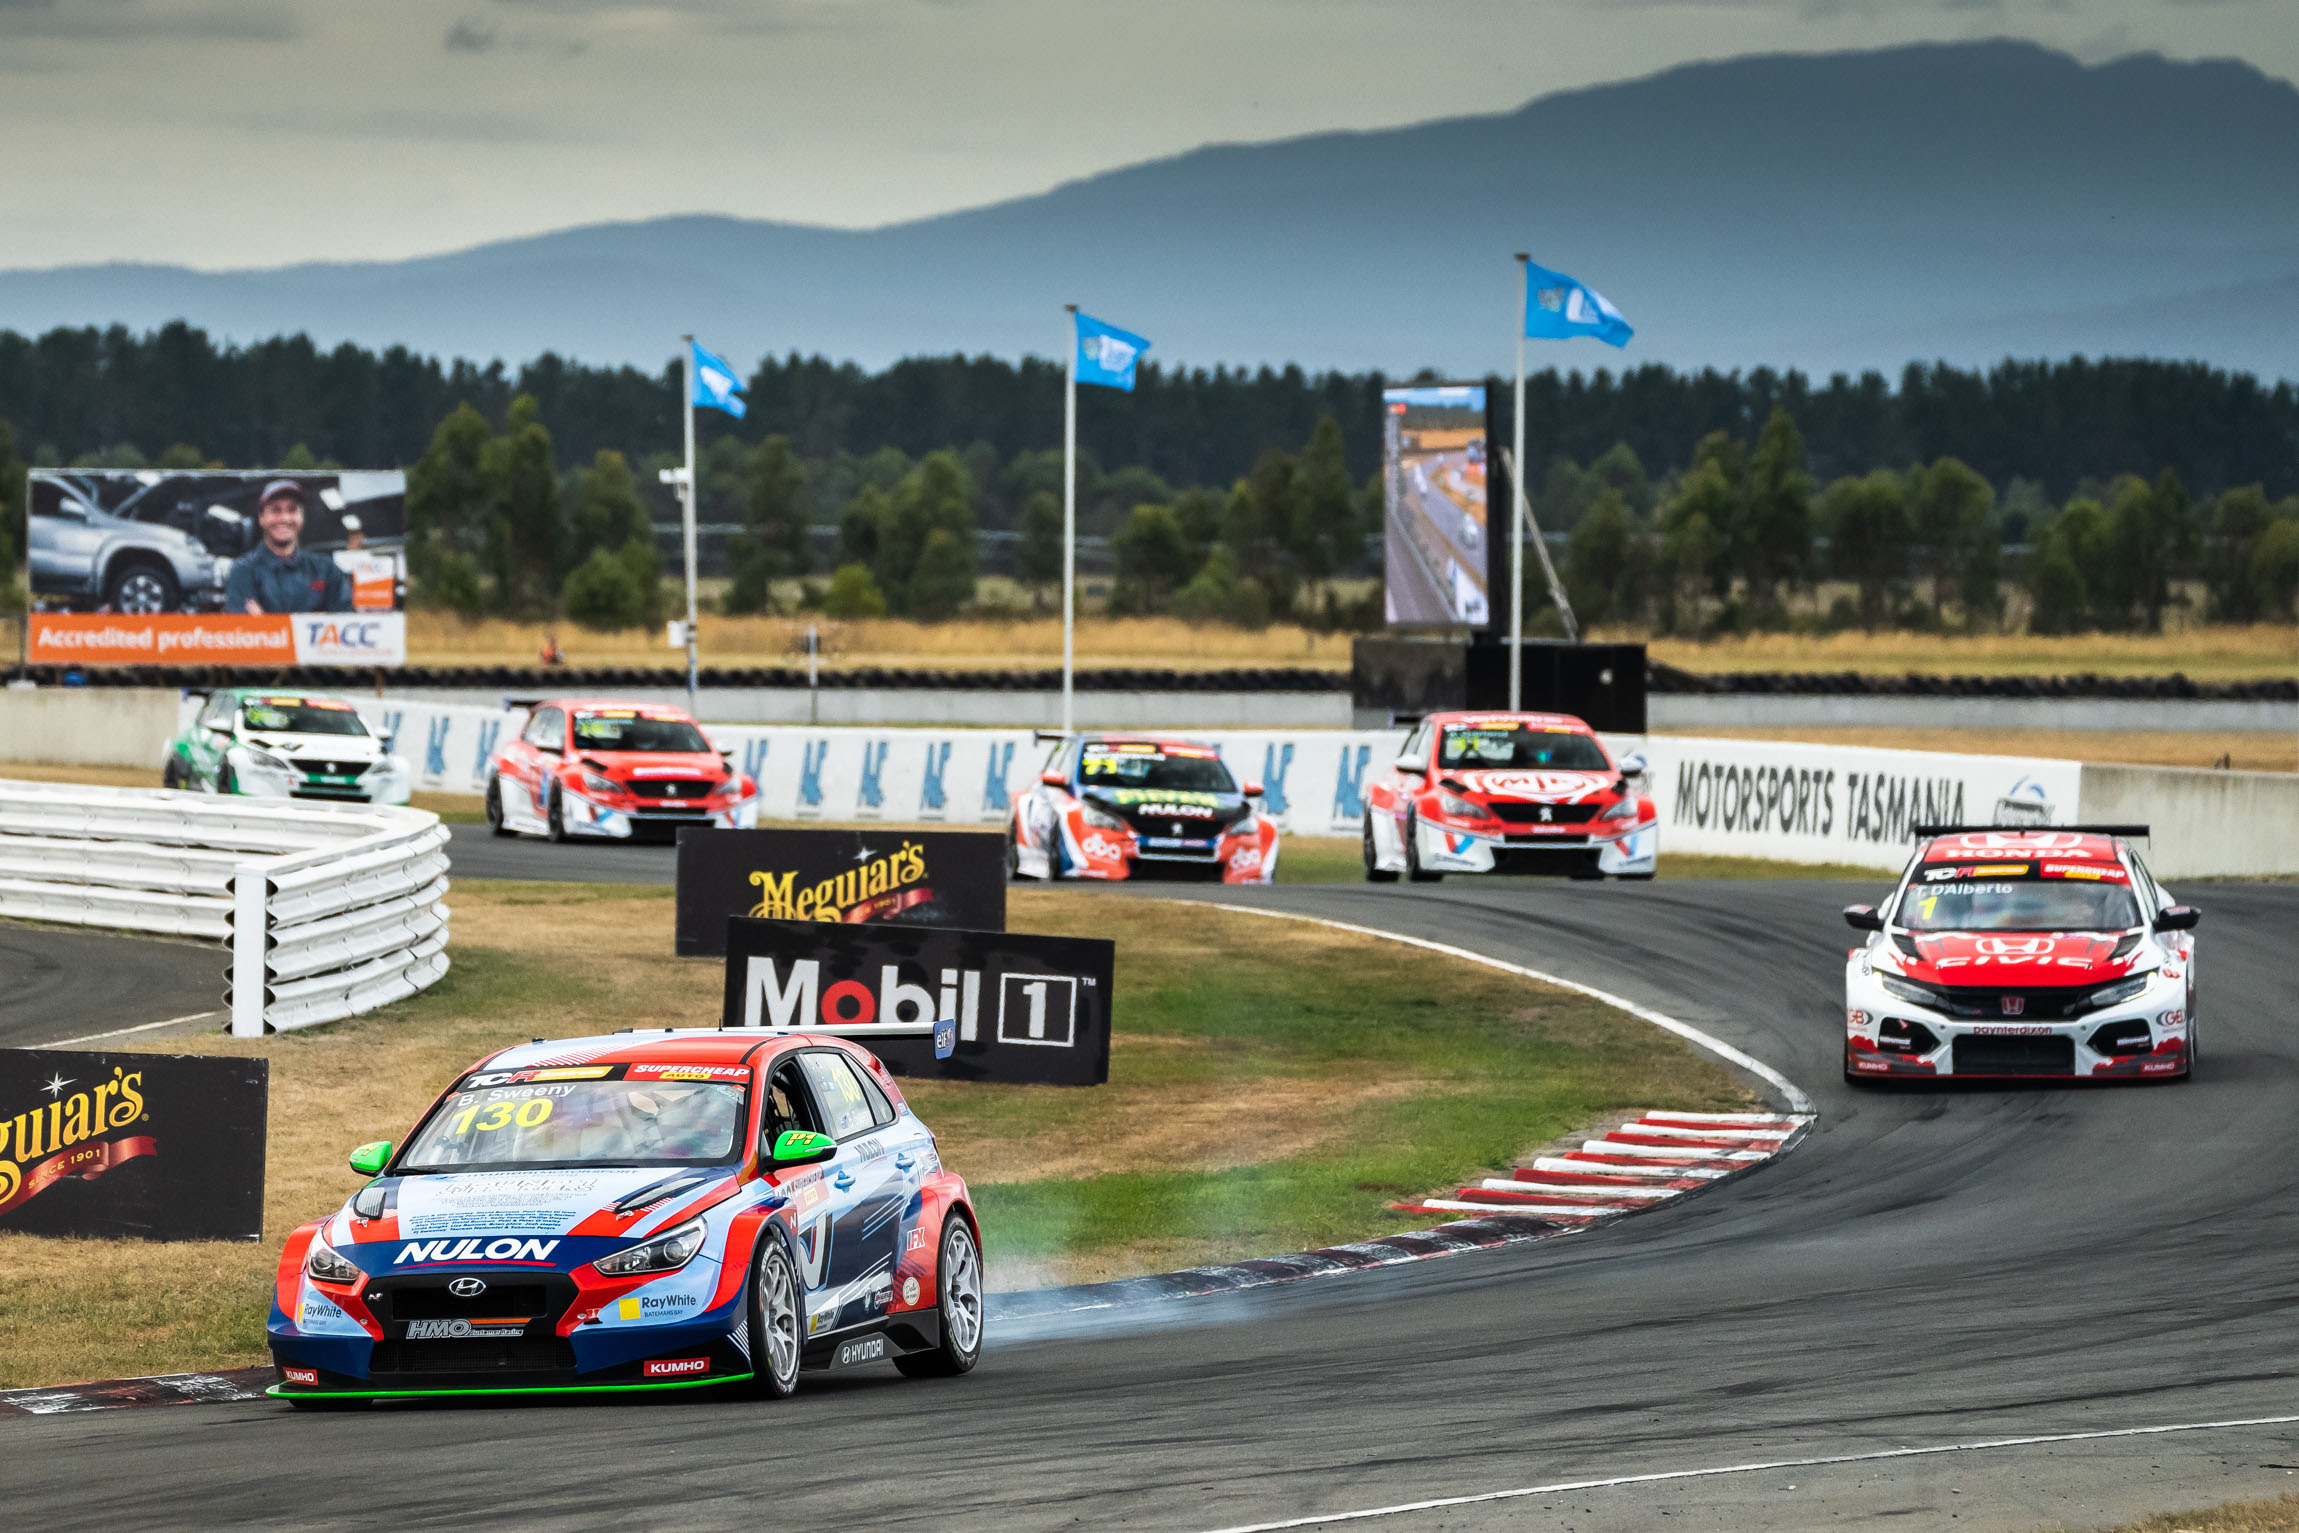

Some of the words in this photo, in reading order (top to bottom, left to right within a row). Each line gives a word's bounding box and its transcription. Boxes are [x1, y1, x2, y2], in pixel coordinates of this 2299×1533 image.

[38, 627, 151, 649] Accredited
[157, 627, 289, 653] professional
[307, 622, 380, 649] TACC
[1674, 761, 1834, 836] MOTORSPORTS
[1848, 771, 1965, 846] TASMANIA
[1945, 848, 2093, 858] HONDA
[2044, 863, 2126, 878] SUPERCHEAP
[749, 841, 924, 923] Meguiar's
[1918, 896, 1937, 920] 1
[1936, 956, 2093, 970] CIVIC
[744, 956, 981, 1042] Mobil
[1022, 981, 1046, 1039] 1
[1973, 1026, 2053, 1036] paynterdixon
[467, 1070, 542, 1089] TCR
[634, 1064, 750, 1077] SUPERCHEAP
[458, 1094, 479, 1107] B.
[488, 1084, 576, 1101] Sweeny
[452, 1098, 553, 1135] 130
[28, 1160, 65, 1190] SINCE
[70, 1148, 101, 1165] 1901
[393, 1238, 561, 1265] NULON
[304, 1303, 342, 1319] RayWhite
[642, 1294, 696, 1309] RayWhite
[644, 1310, 674, 1318] BATEMANS
[406, 1319, 472, 1340] HMO
[851, 1338, 884, 1362] HYUNDAI
[286, 1370, 315, 1382] KUMHO
[650, 1360, 705, 1374] KUMHO
